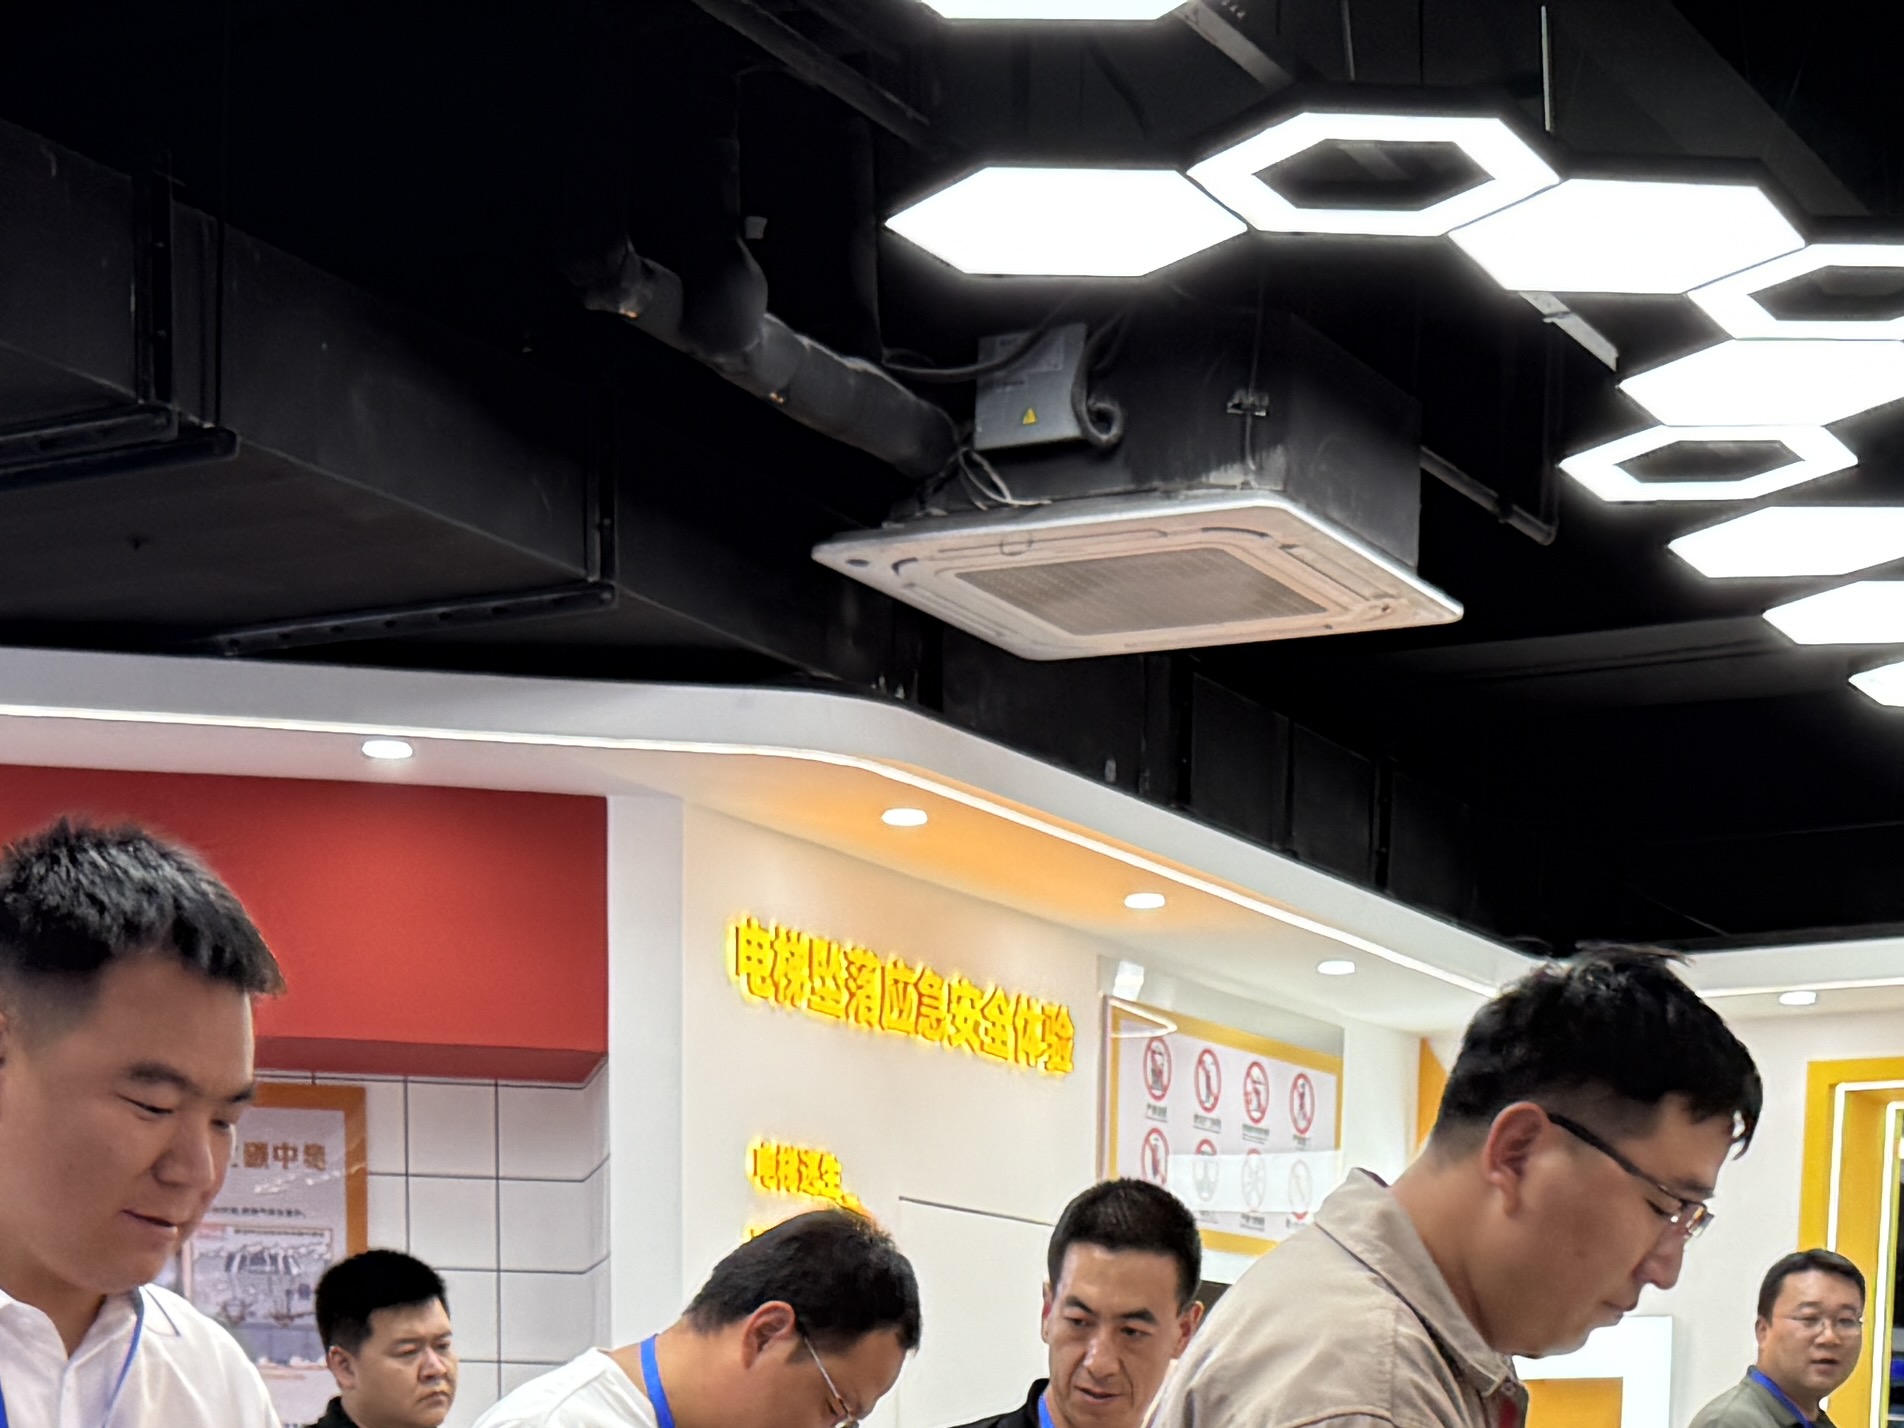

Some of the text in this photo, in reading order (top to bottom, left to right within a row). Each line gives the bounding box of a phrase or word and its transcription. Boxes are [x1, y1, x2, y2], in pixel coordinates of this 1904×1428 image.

[734, 916, 1075, 1074] 电梯坠落应急安全体验
